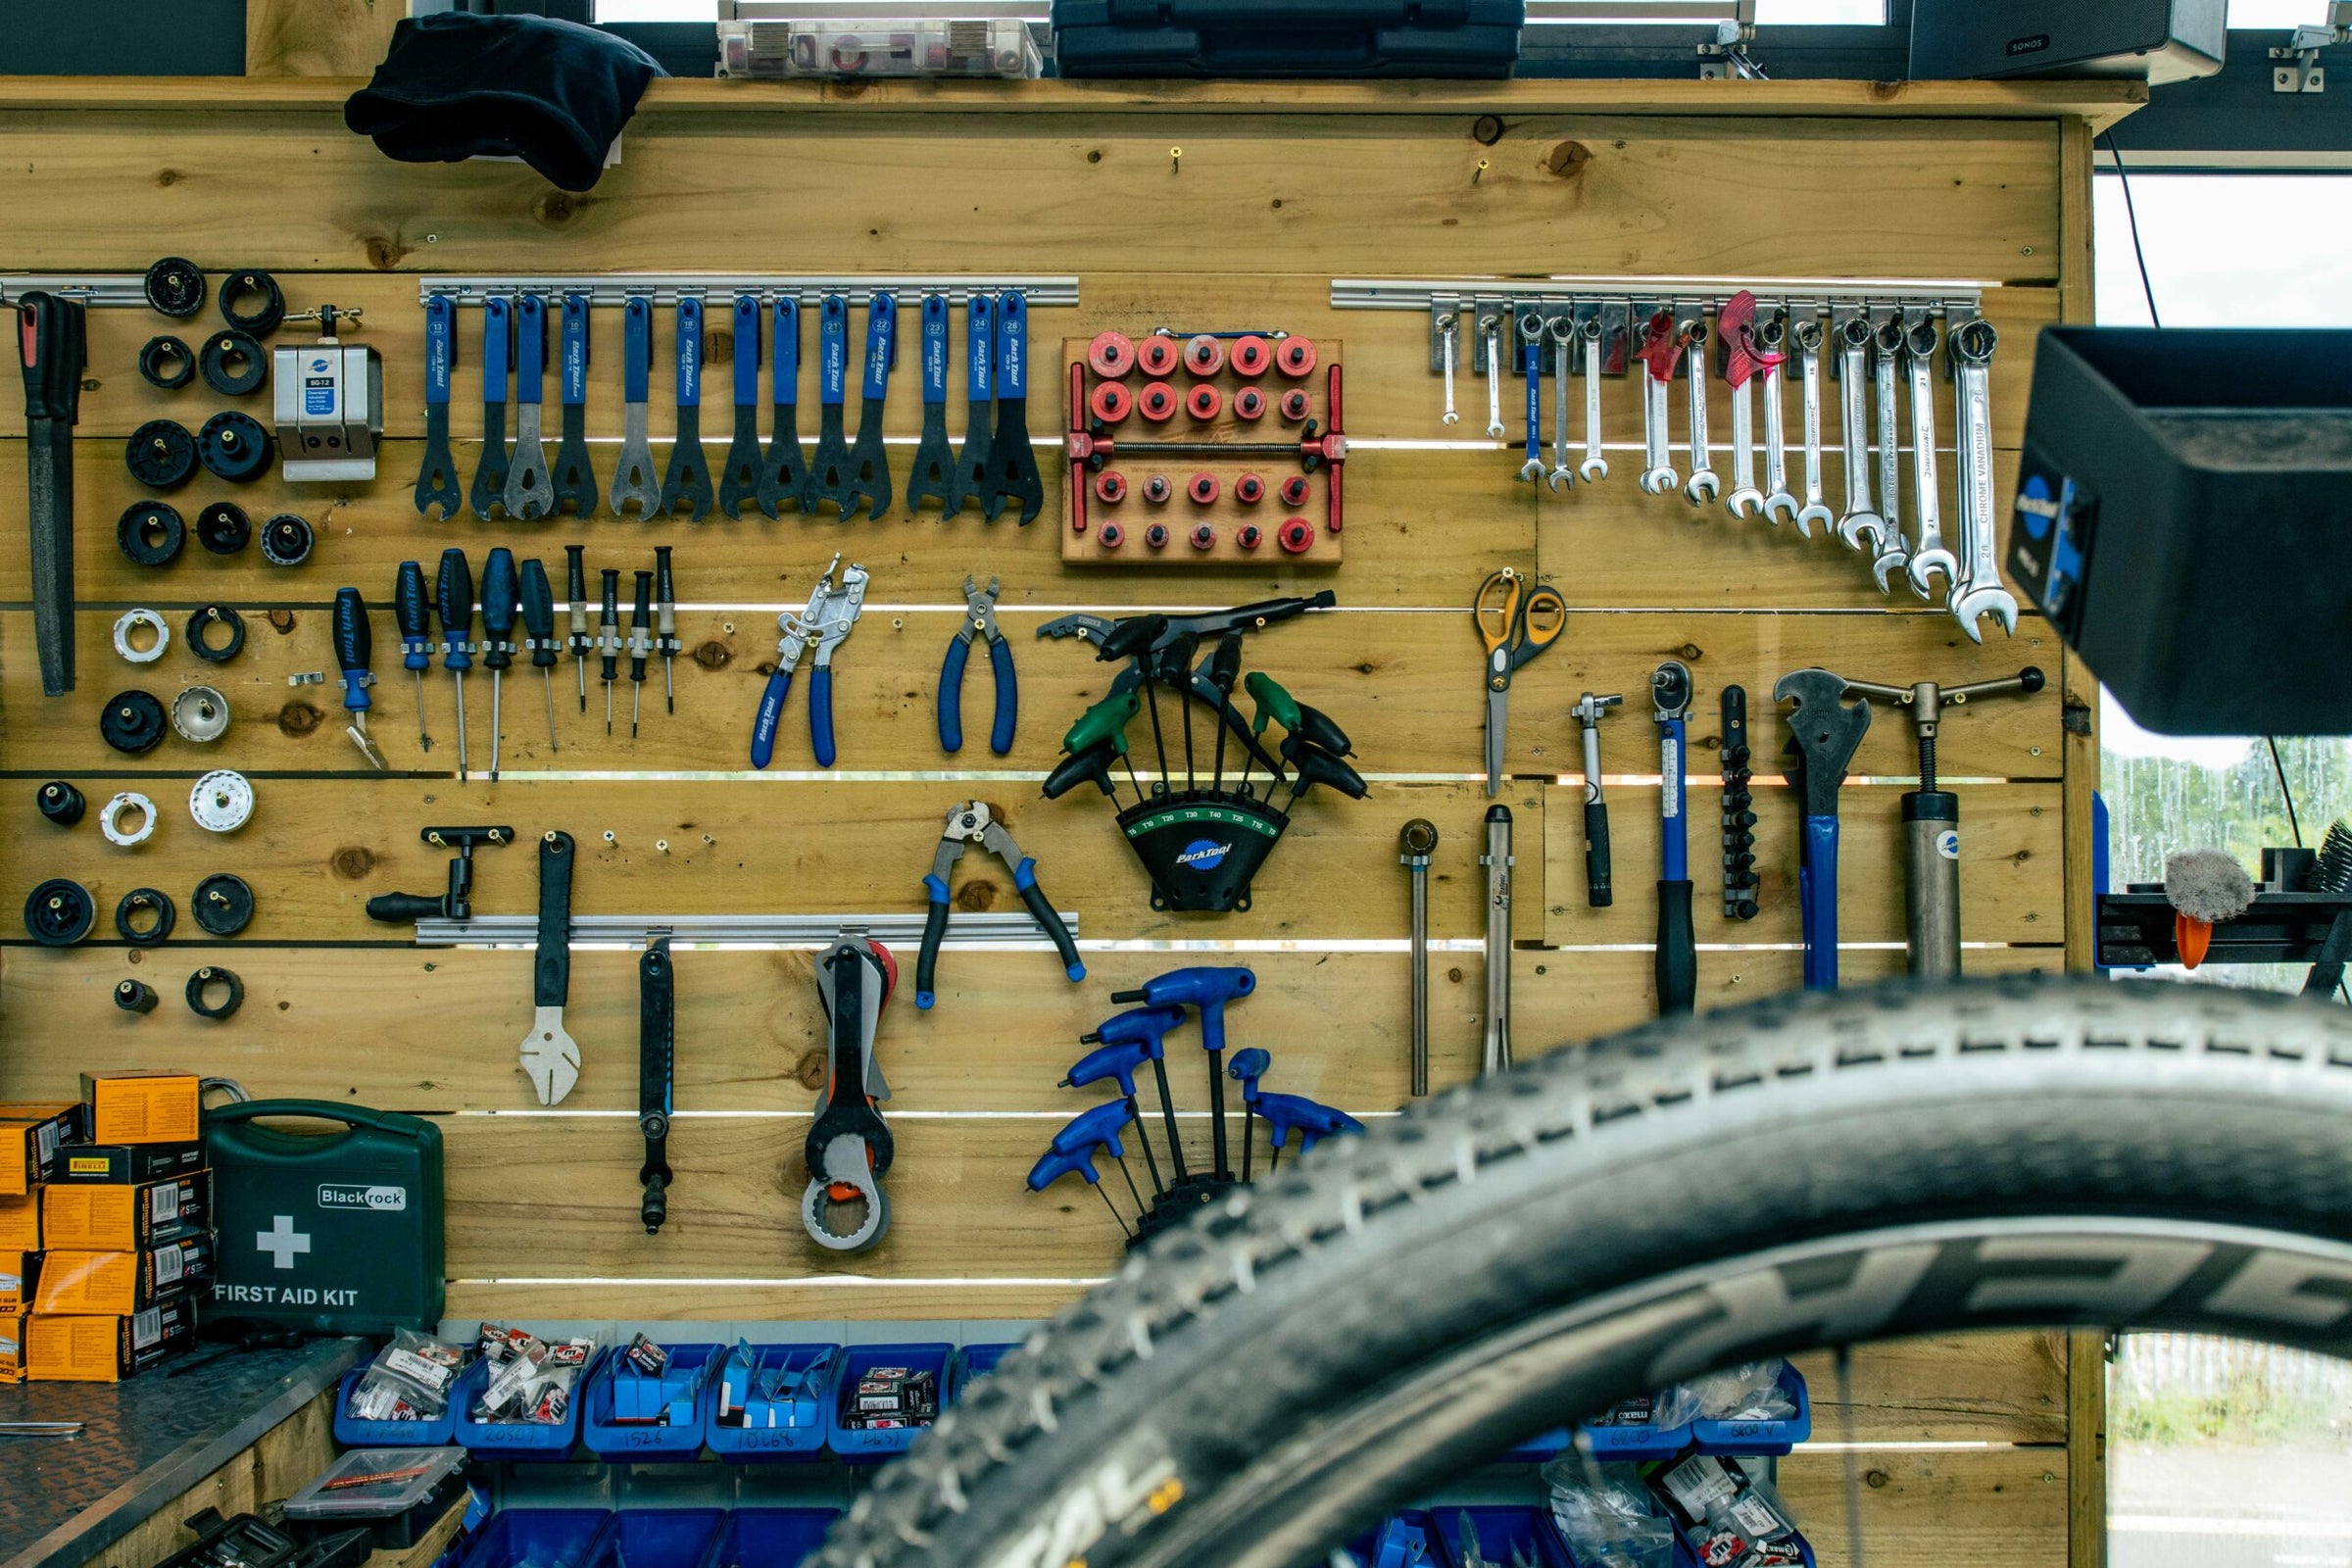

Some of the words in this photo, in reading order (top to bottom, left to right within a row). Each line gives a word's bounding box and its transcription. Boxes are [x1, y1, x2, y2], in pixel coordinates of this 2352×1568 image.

[2012, 39, 2042, 52] SONOS
[1919, 376, 1927, 387] 21
[1977, 422, 1986, 477] VANADIUM
[1979, 480, 1988, 524] CHROME
[1927, 518, 1935, 529] 21
[1232, 813, 1244, 822] T25
[1143, 820, 1154, 829] T10
[1251, 820, 1263, 829] T15
[73, 1160, 106, 1169] PIRELLI
[321, 1189, 402, 1204] Blackrock
[215, 1285, 276, 1302] FIRST
[280, 1288, 318, 1304] AID
[323, 1290, 359, 1306] KIT
[624, 1431, 662, 1446] 1526
